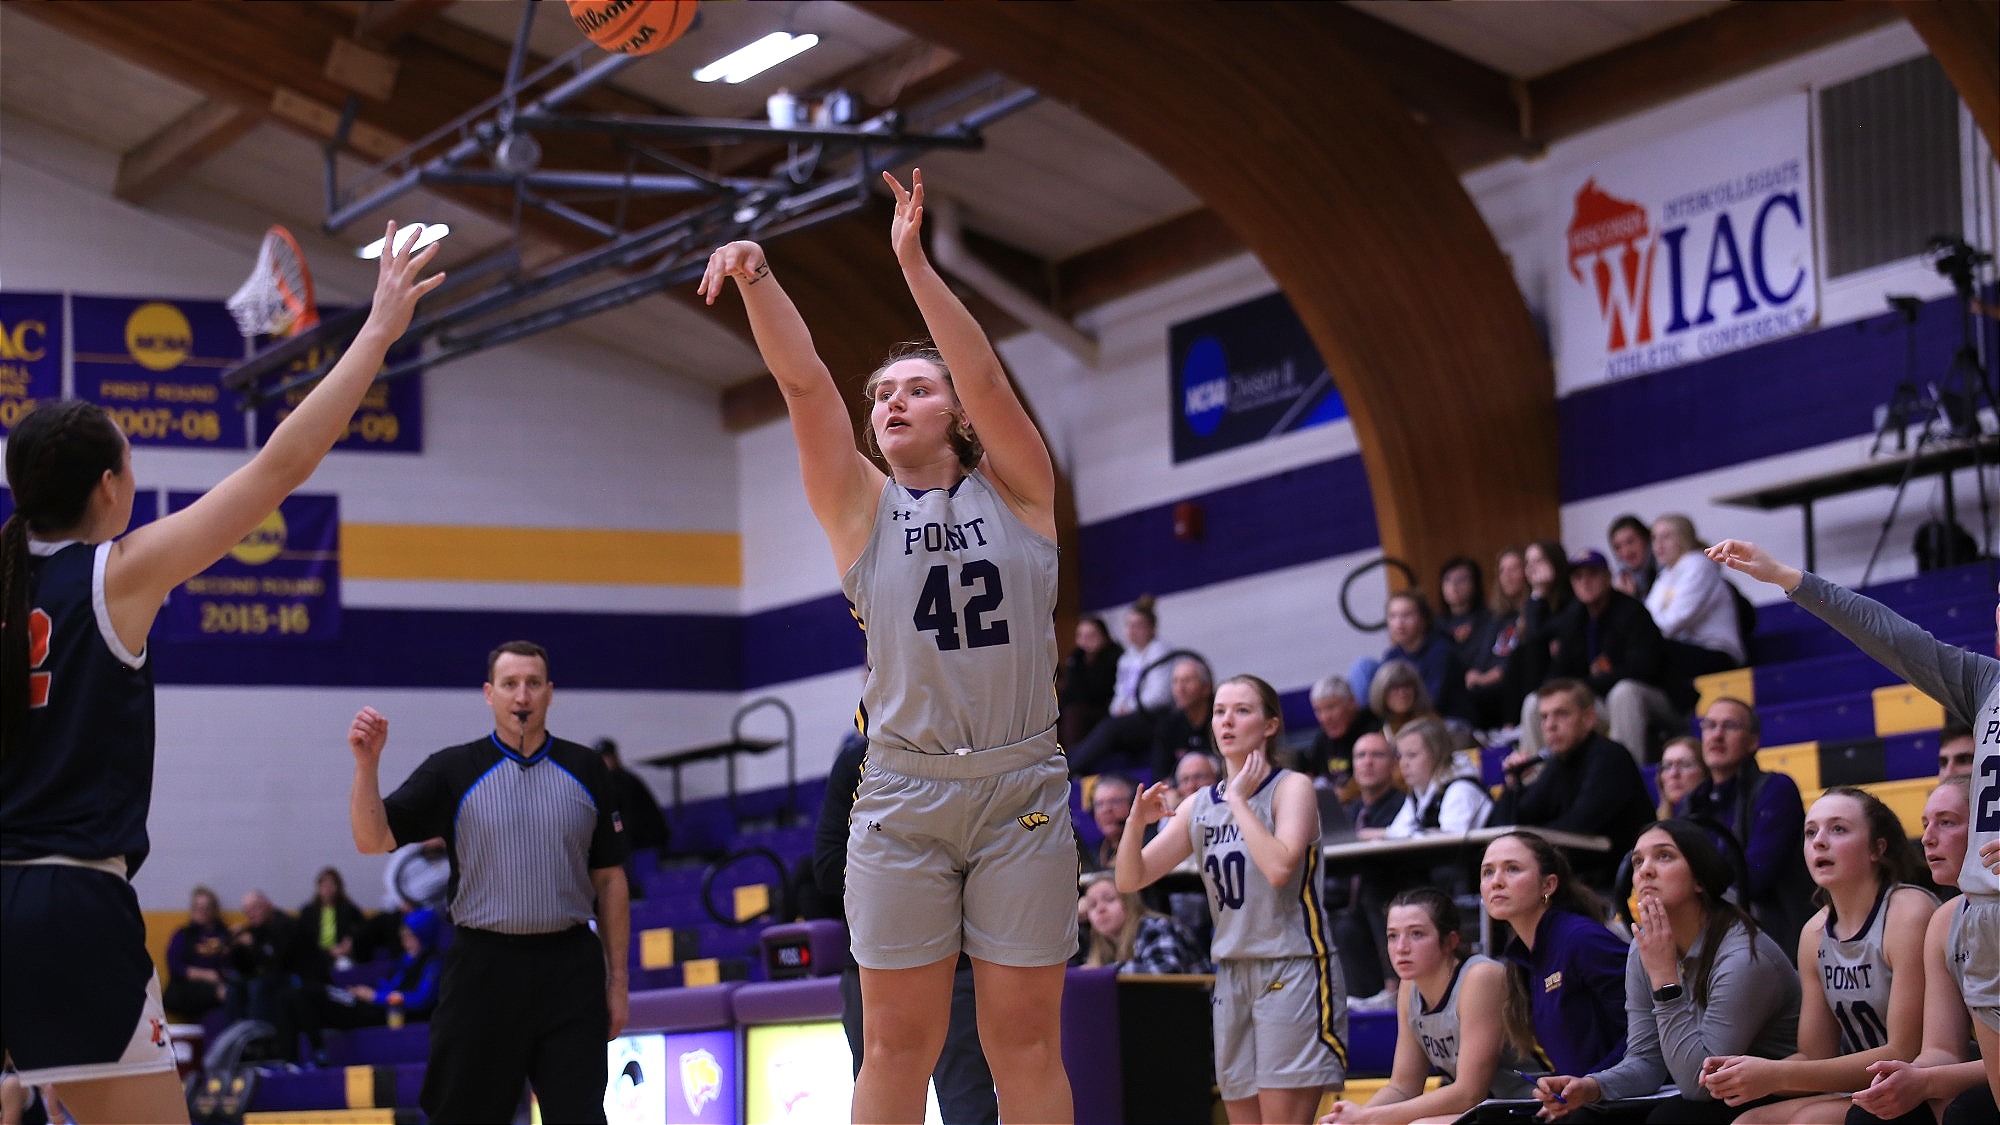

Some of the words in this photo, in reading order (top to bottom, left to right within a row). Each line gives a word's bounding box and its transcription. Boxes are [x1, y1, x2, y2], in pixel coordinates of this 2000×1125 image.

[201, 602, 310, 635] 2015-16
[913, 559, 1010, 651] 42
[1204, 850, 1245, 912] 30
[1824, 963, 1872, 990] POINT
